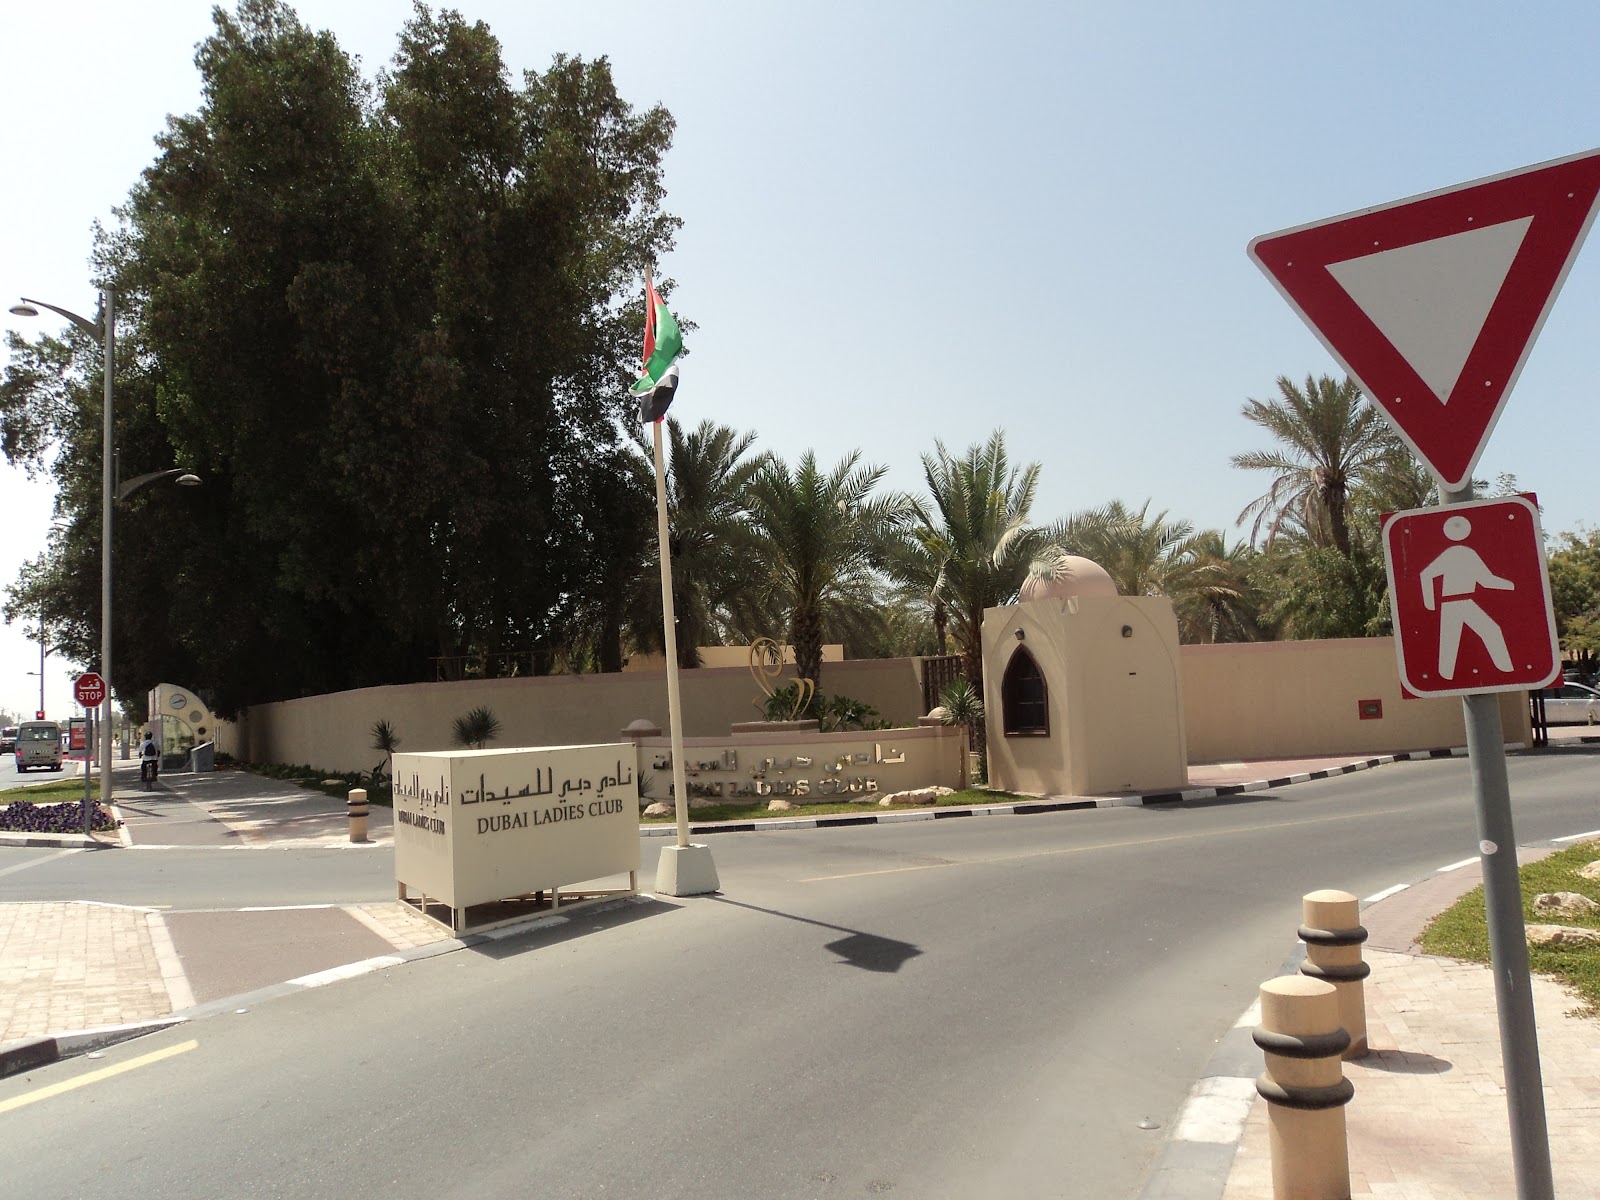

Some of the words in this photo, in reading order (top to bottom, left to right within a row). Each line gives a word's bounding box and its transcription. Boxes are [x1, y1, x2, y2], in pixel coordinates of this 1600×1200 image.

[78, 691, 102, 701] STOP
[460, 766, 553, 806] للسيدات
[558, 778, 591, 804] دبي
[597, 760, 632, 798] نادي
[728, 779, 812, 797] LADIES
[818, 776, 879, 795] CLUB
[430, 817, 446, 835] CLUB
[477, 812, 529, 835] DUBAI
[533, 804, 585, 826] LADIES
[588, 799, 623, 817] CLUB
